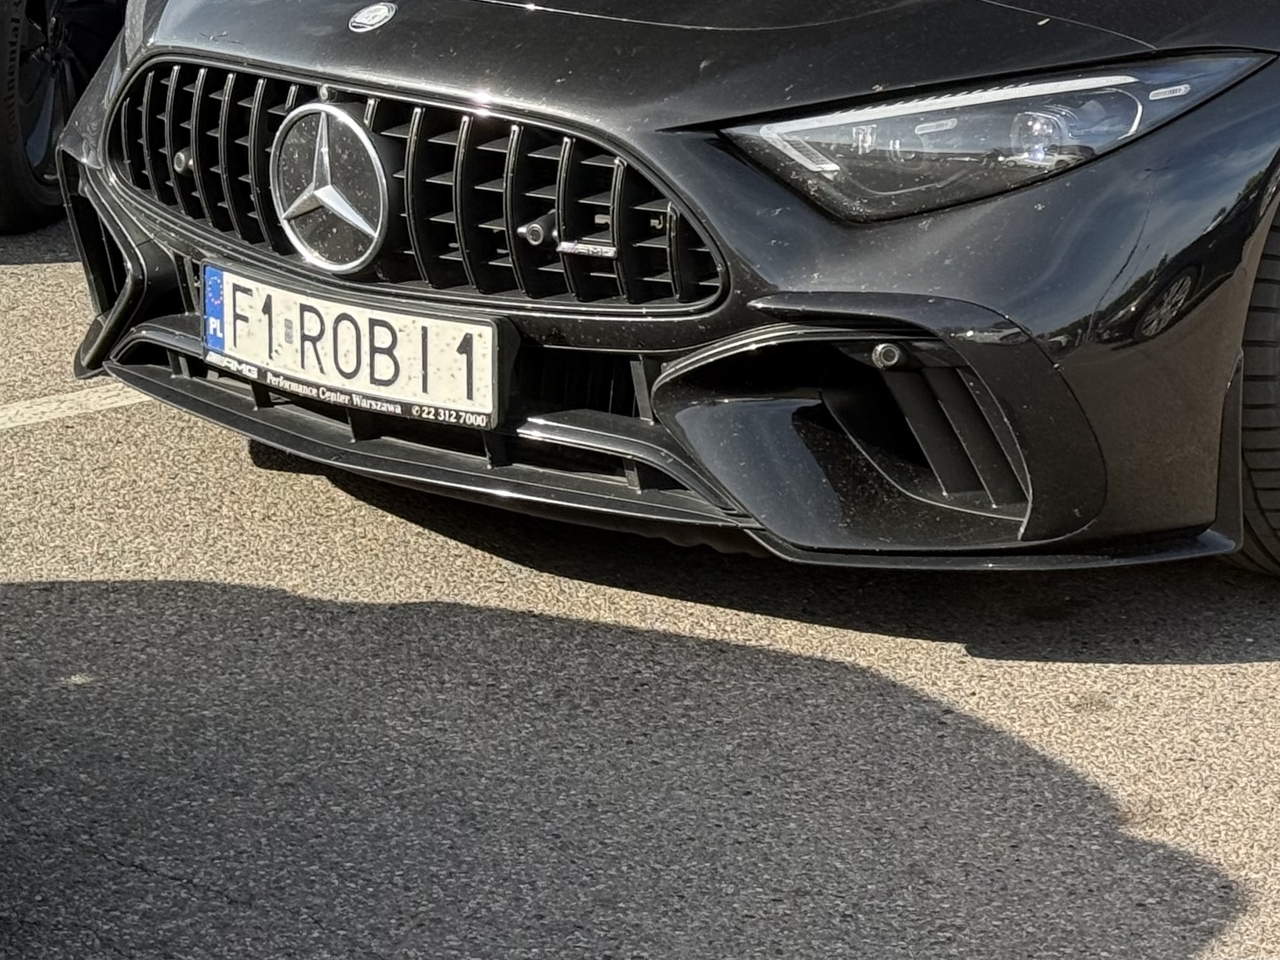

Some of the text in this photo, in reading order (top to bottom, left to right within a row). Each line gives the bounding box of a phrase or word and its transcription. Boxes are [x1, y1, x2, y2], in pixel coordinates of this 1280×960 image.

[208, 319, 224, 339] PL
[231, 282, 274, 361] F1
[219, 358, 487, 427] AMG Performance Center Warszawa 22 312 7000
